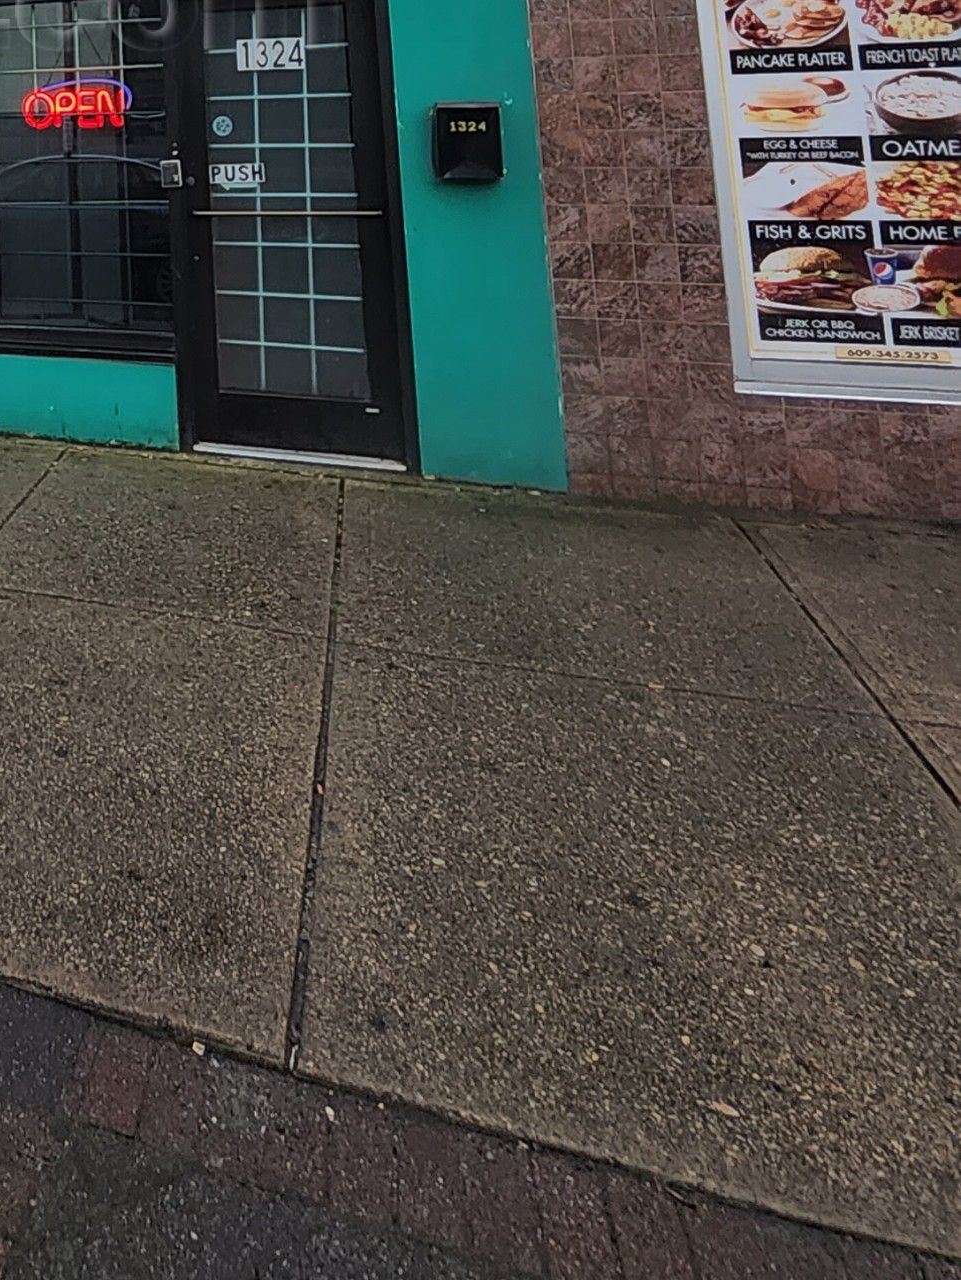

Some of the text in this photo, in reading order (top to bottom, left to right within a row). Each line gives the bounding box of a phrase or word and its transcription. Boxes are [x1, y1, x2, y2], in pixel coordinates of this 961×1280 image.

[240, 39, 304, 69] 1324
[736, 51, 846, 69] PANCAKE PLATTER
[866, 49, 905, 64] FRENCH
[908, 47, 939, 62] TOAST
[22, 88, 126, 130] OPEN
[449, 120, 487, 132] 1324
[763, 139, 839, 150] EGG & CHEESE
[882, 139, 961, 157] OATME
[829, 151, 859, 159] BACON
[211, 164, 264, 182] PUSH
[755, 225, 867, 240] FISH & GRITS
[889, 225, 948, 241] HOME
[785, 319, 855, 330] JERK OR BBQ
[899, 325, 921, 339] JERK
[765, 328, 881, 341] CHICKEN SANDWICH
